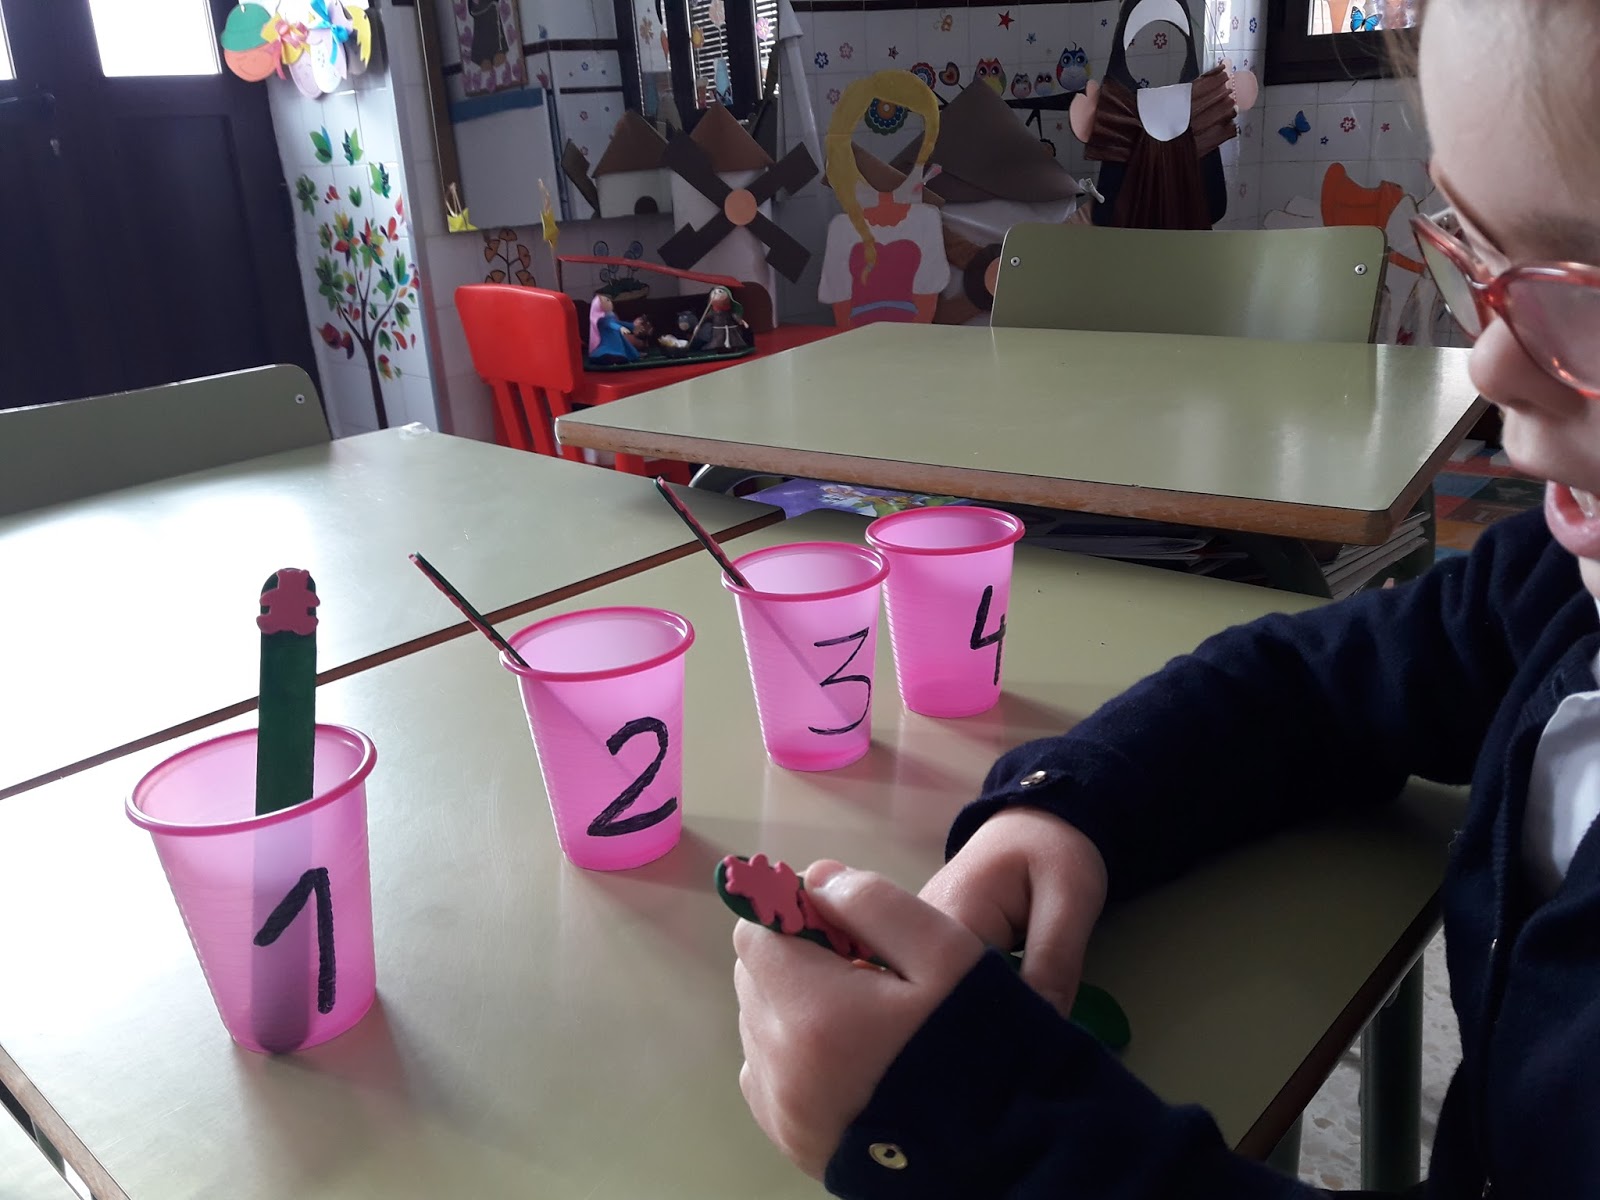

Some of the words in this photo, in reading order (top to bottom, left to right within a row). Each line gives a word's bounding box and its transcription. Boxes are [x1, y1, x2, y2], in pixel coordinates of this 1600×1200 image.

[807, 626, 872, 736] 3
[969, 584, 1007, 686] 4
[587, 716, 678, 837] 2
[253, 866, 336, 1014] 1
